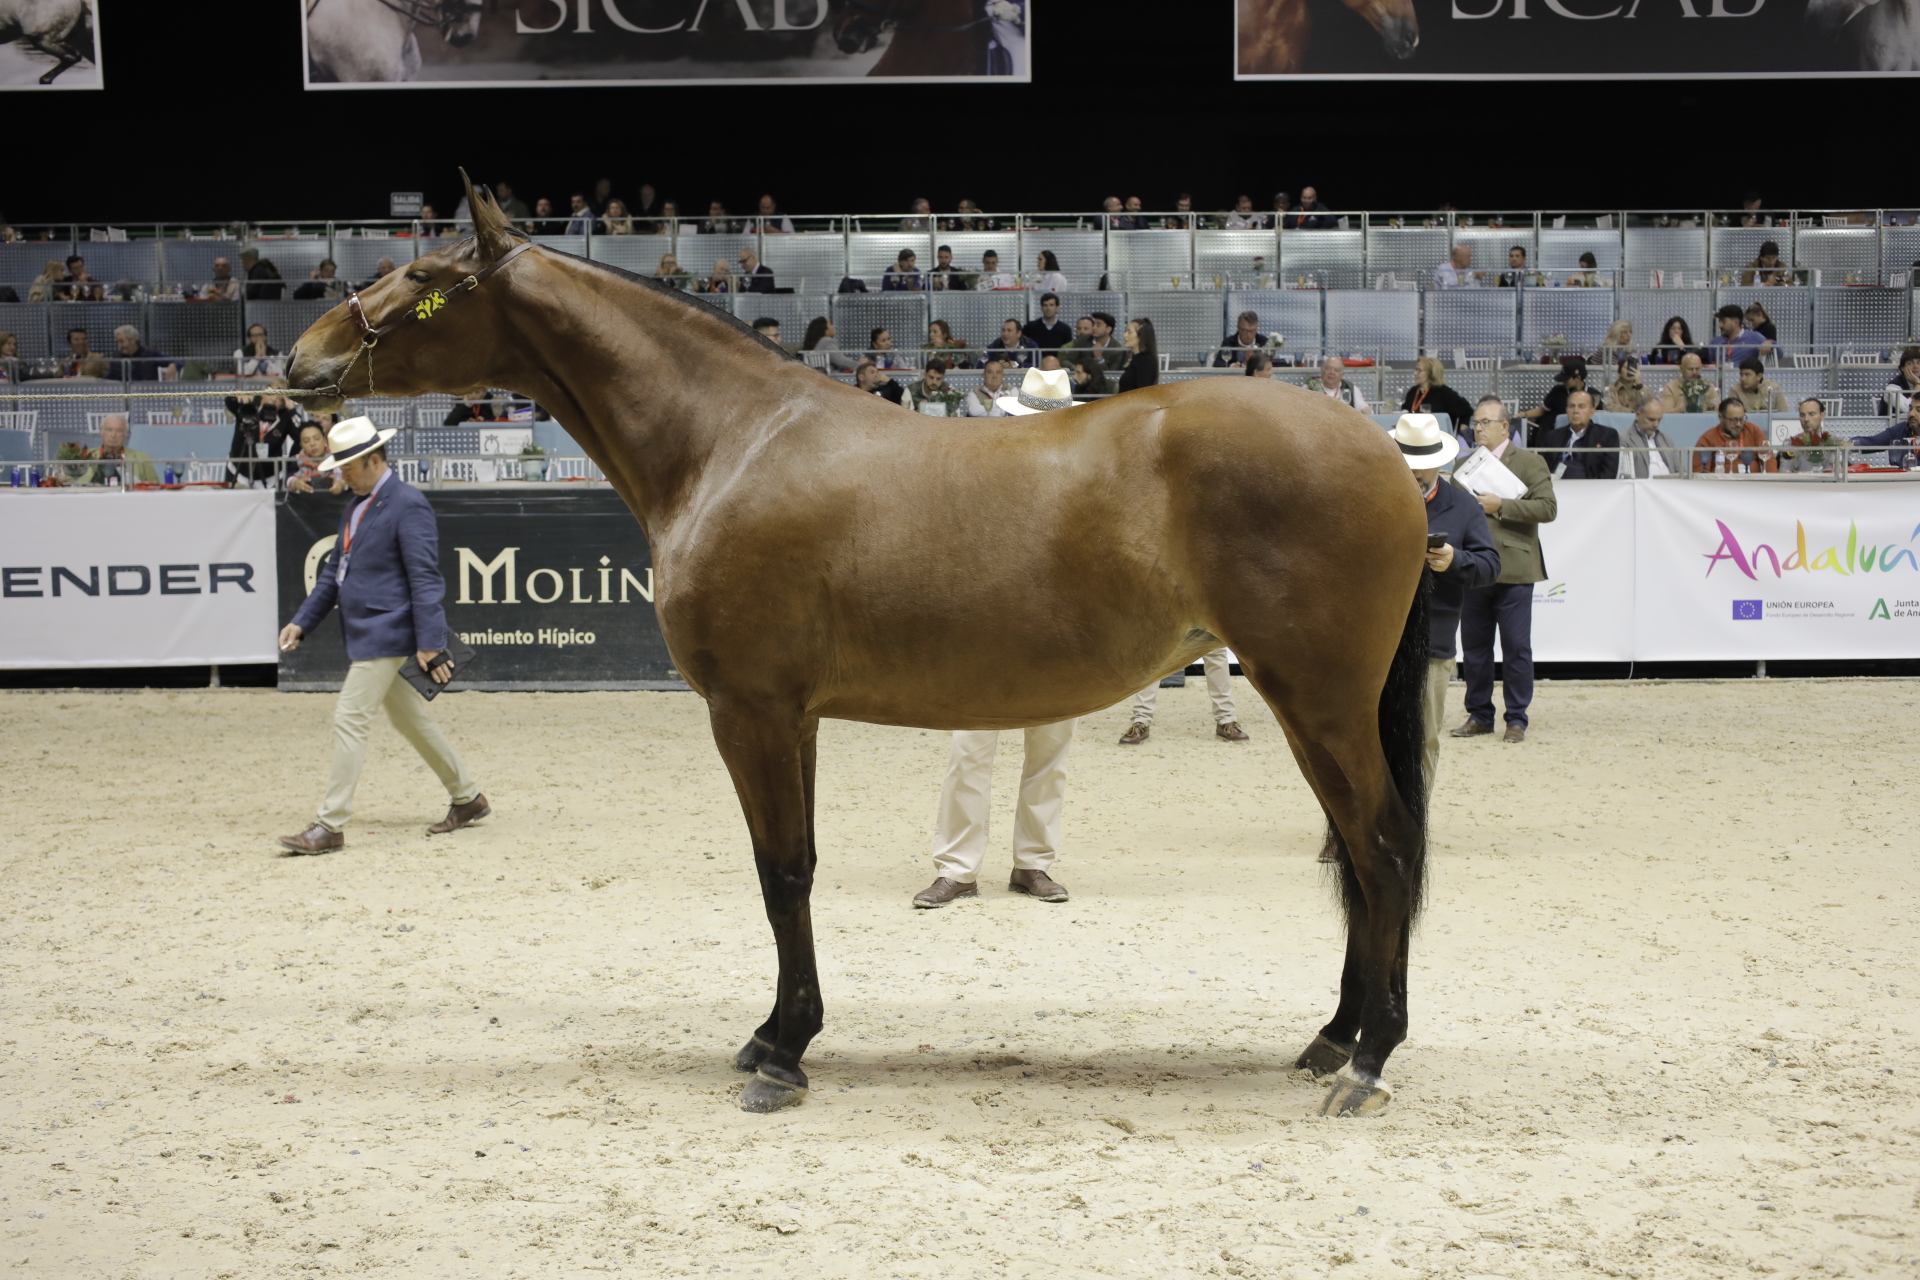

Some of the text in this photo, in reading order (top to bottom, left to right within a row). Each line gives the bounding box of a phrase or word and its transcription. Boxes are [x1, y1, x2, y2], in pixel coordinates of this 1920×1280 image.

[412, 288, 448, 320] 523
[2, 562, 257, 598] ENDER
[1766, 600, 1834, 609] UNIÓN EUROPEA
[1894, 599, 1919, 608] Junta
[1894, 609, 1905, 617] de
[455, 627, 596, 648] amiento Hípico
